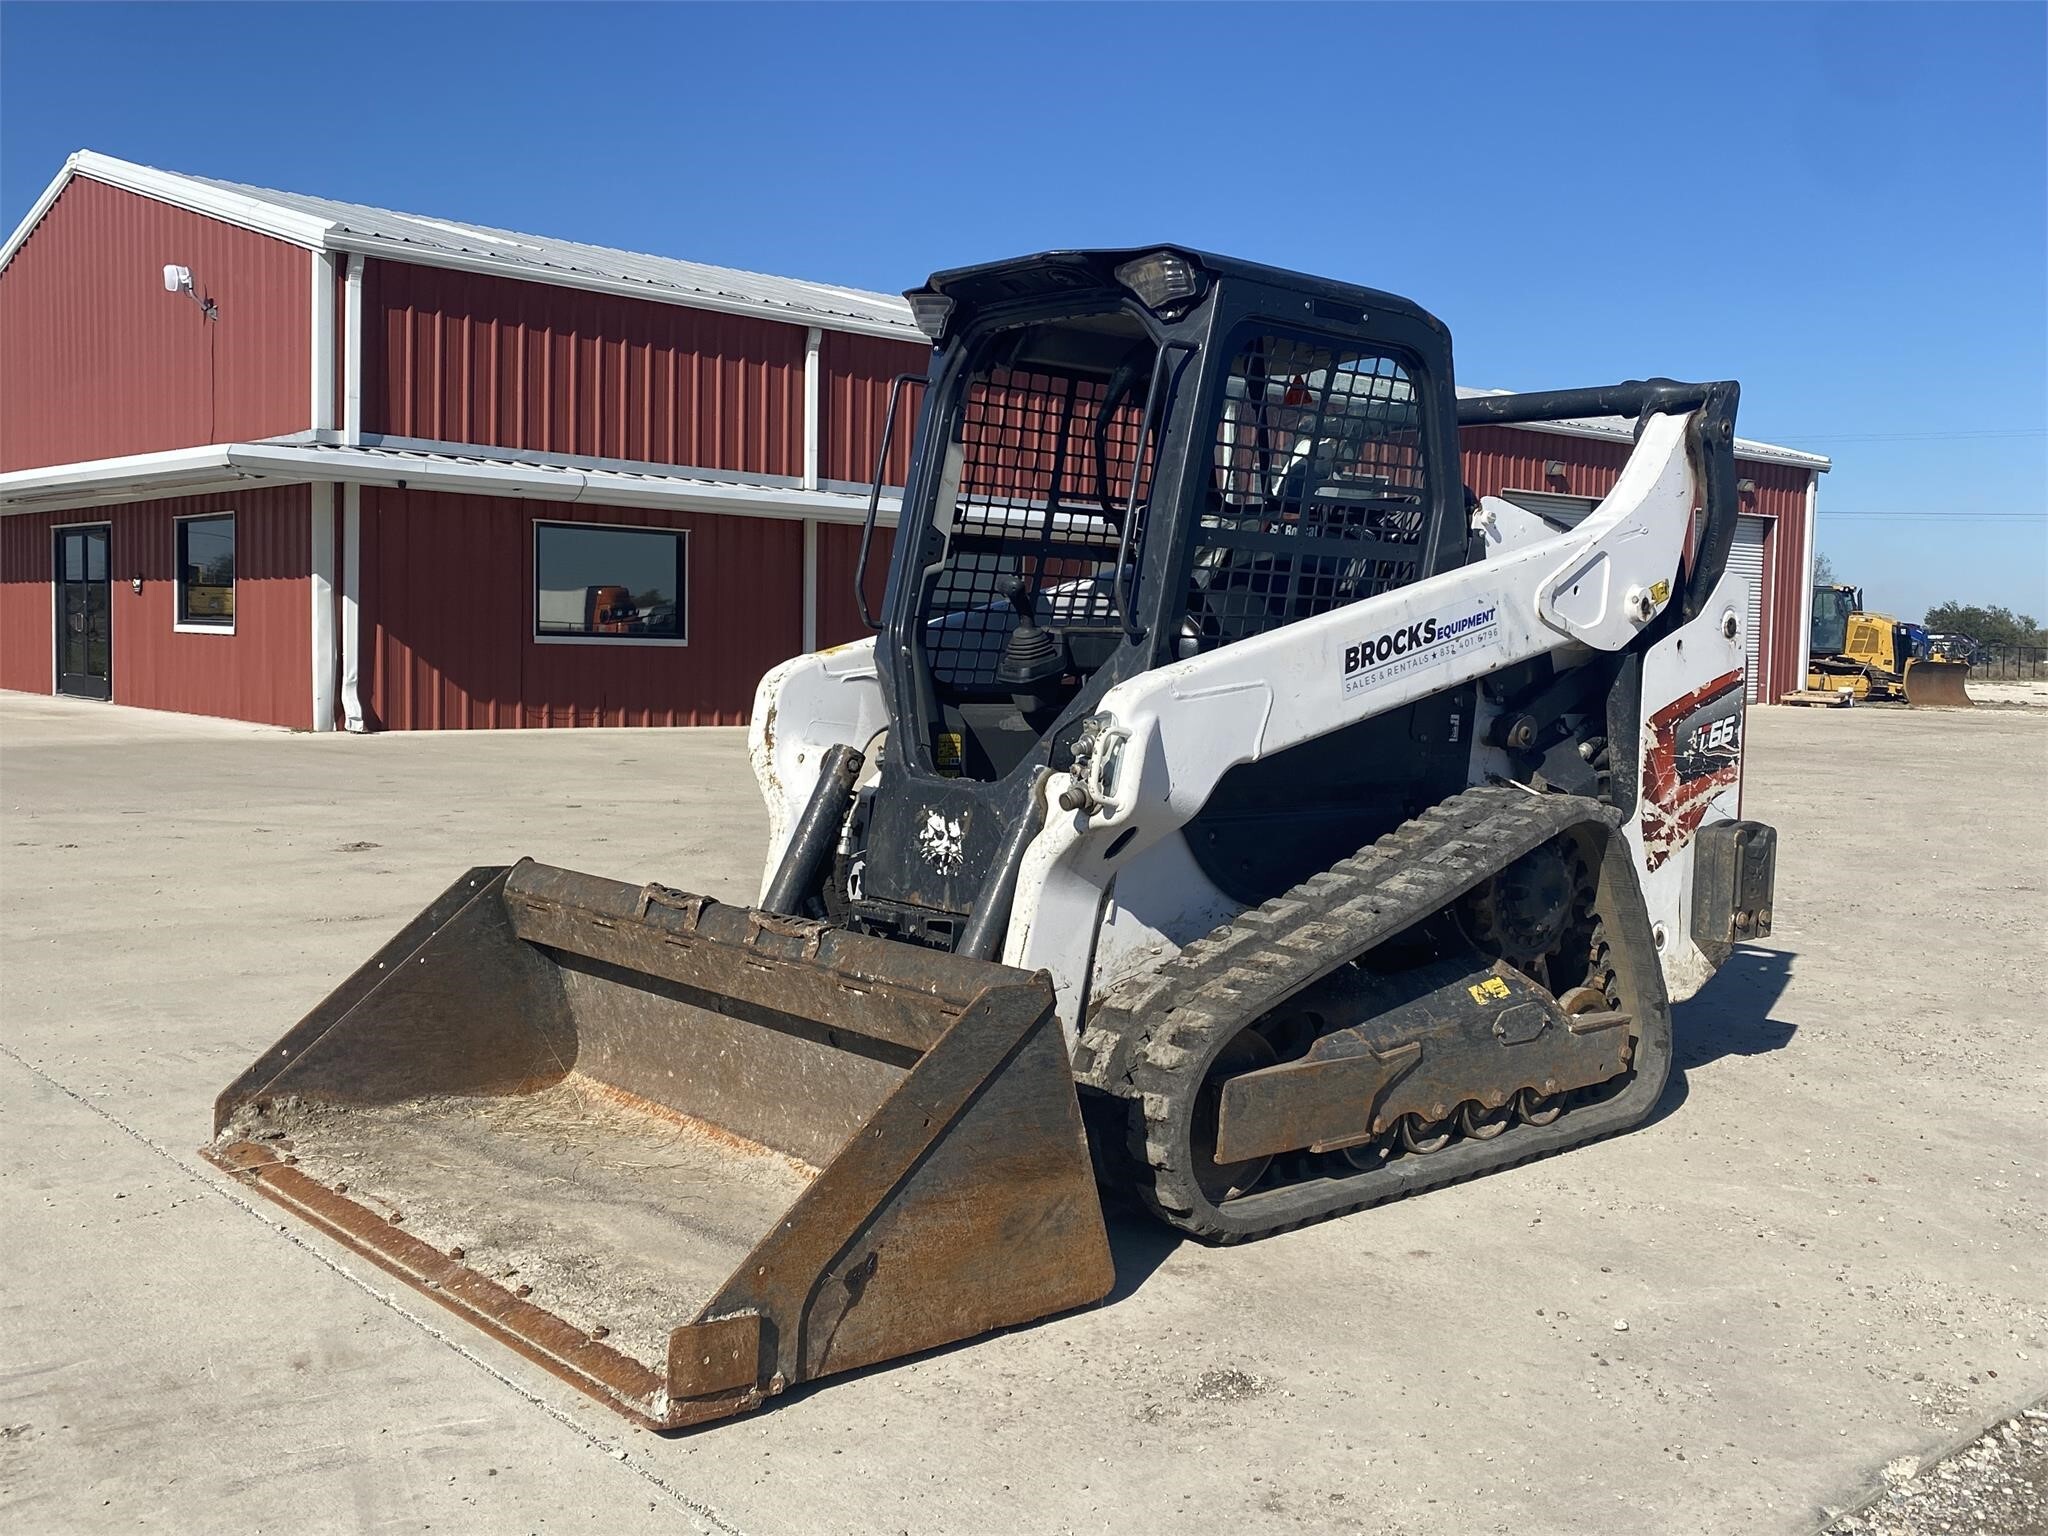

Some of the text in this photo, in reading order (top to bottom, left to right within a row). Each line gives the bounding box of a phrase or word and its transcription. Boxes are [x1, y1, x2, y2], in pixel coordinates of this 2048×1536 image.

[1345, 608, 1496, 674] BROCKS EQUIPMENT
[1346, 674, 1377, 692] SALES
[1379, 671, 1385, 680] &
[1387, 654, 1429, 677] RENTALS
